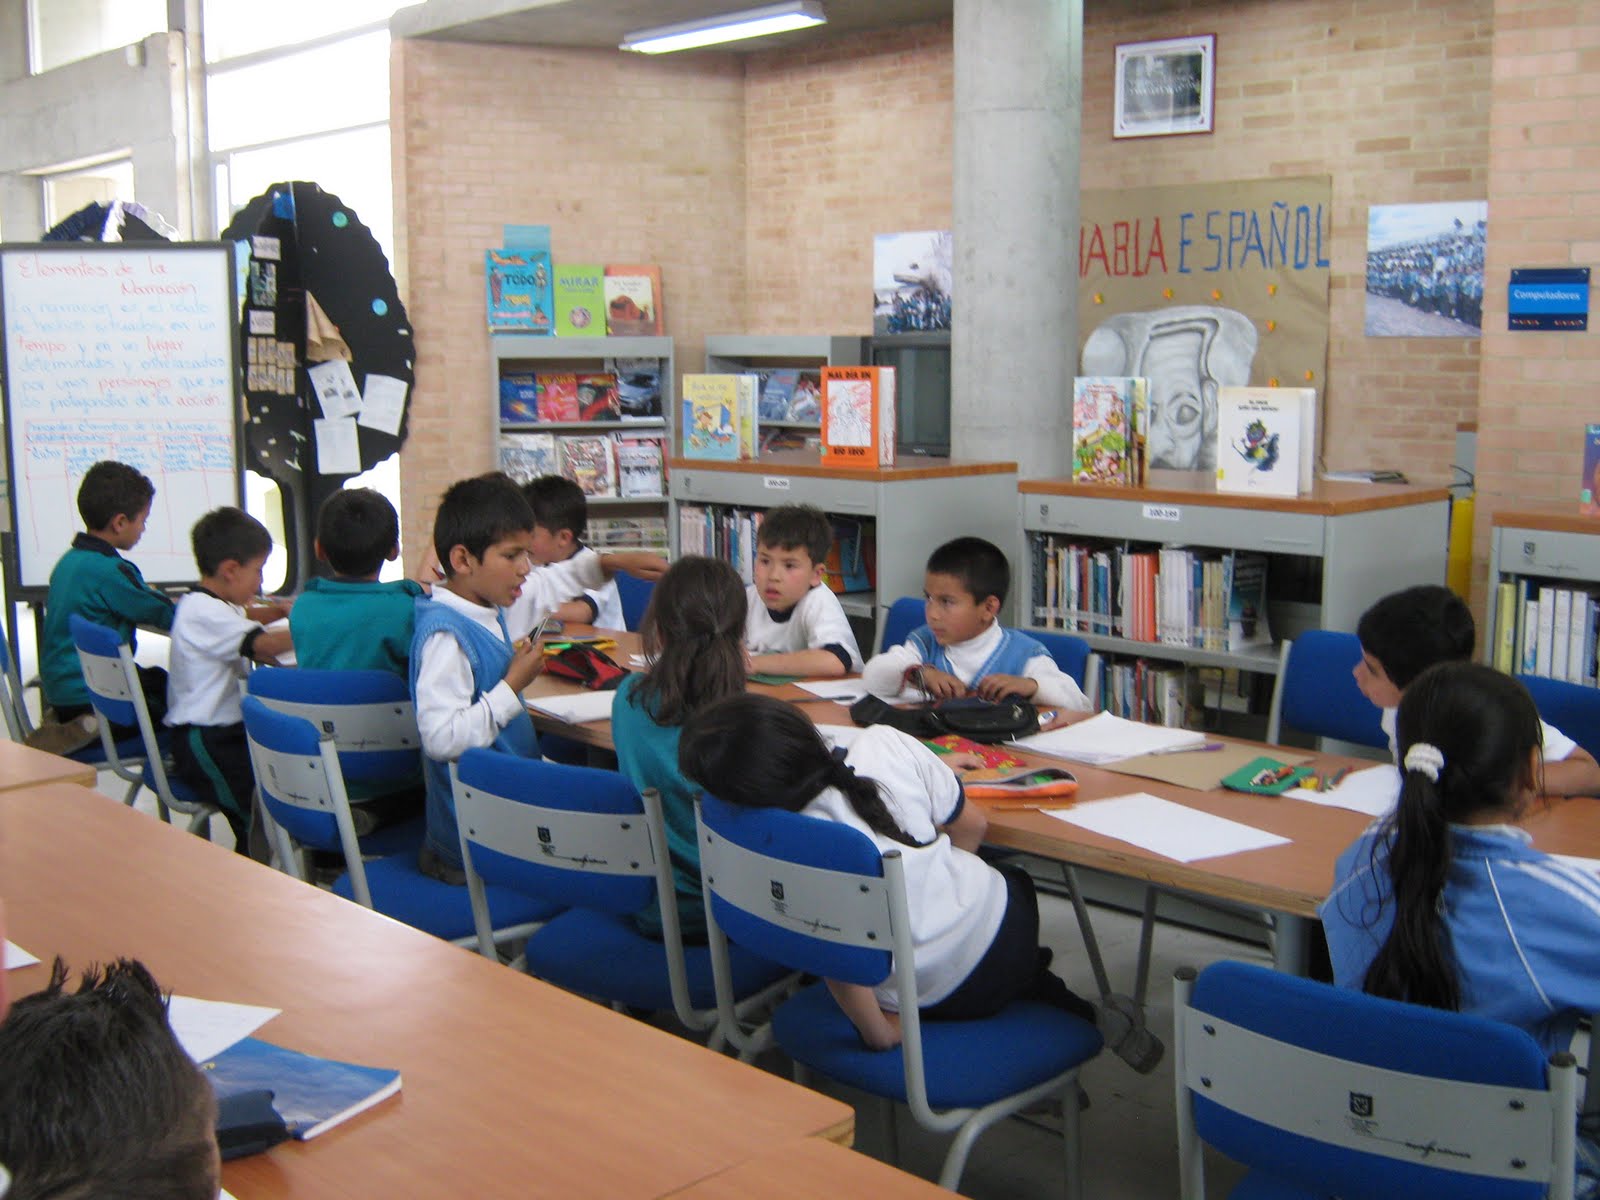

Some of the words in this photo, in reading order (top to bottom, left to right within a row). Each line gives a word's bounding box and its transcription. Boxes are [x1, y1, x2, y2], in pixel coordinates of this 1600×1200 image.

[1177, 200, 1331, 274] ESPAÑOL
[18, 252, 109, 278] Elementos
[148, 256, 169, 275] la
[559, 275, 599, 288] MIRAR
[1513, 288, 1581, 301] Computadores
